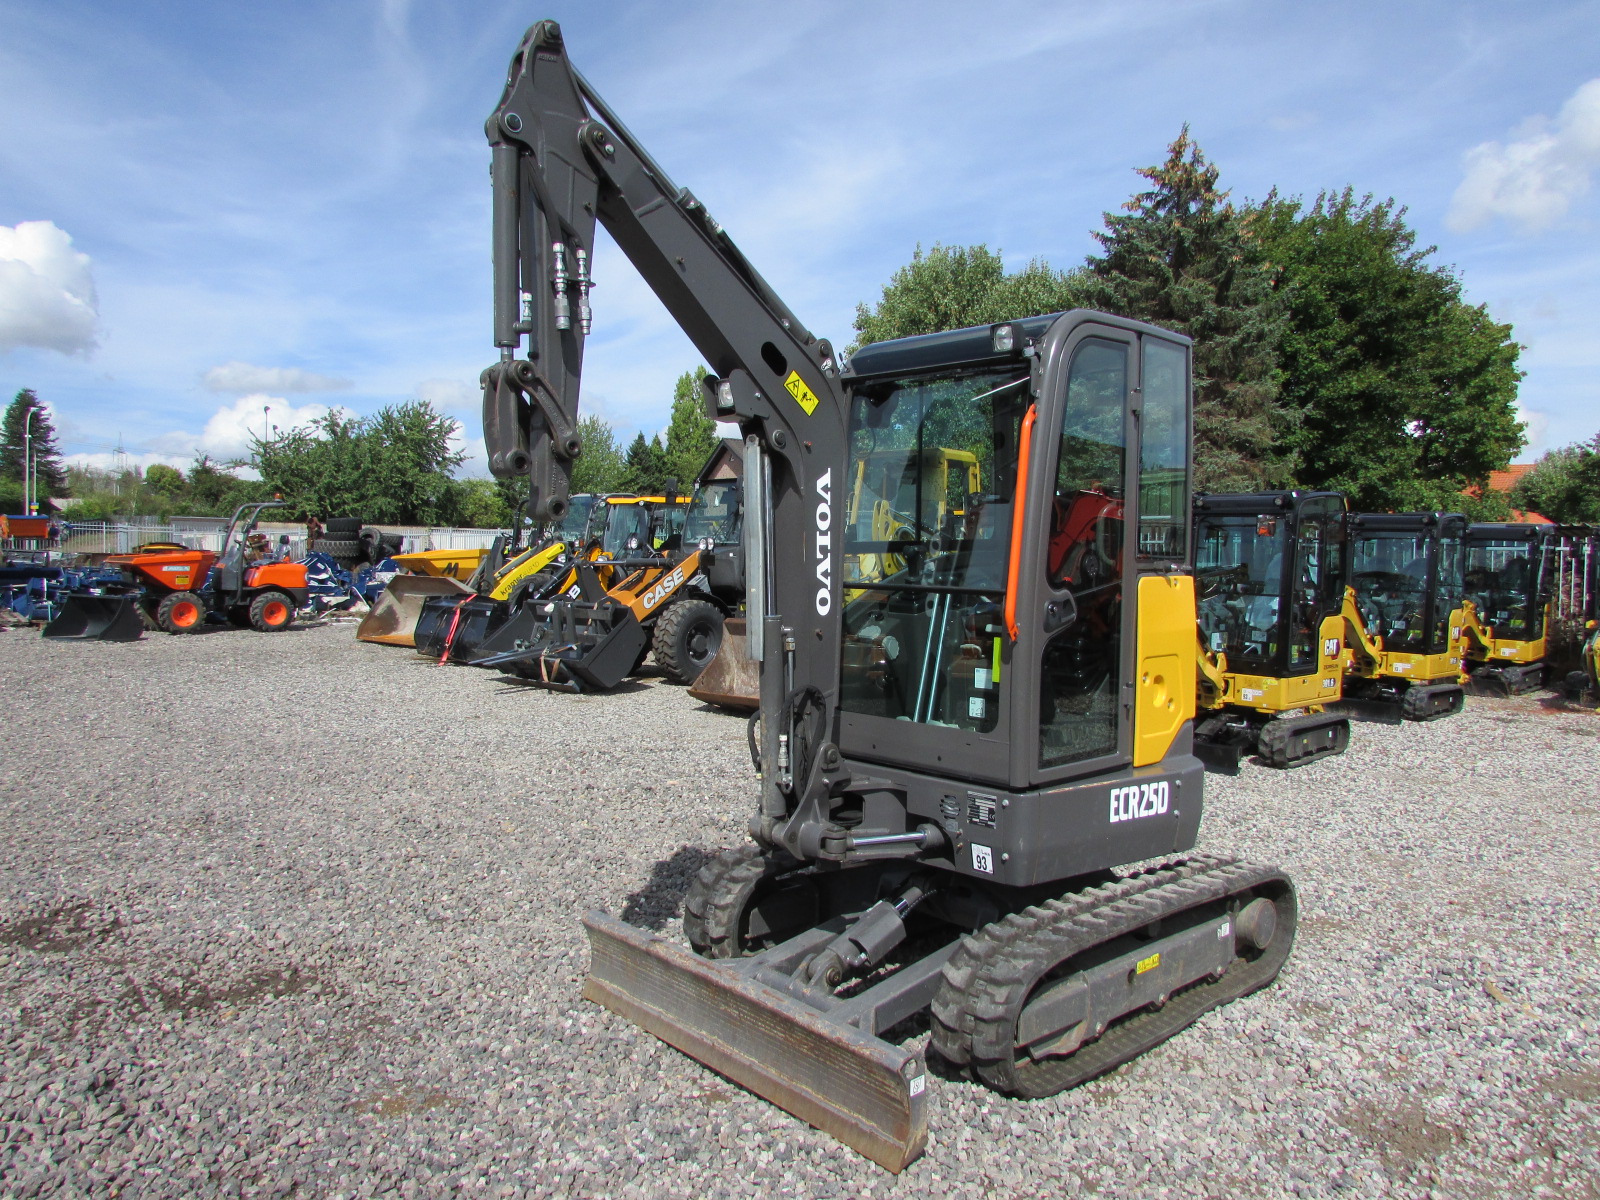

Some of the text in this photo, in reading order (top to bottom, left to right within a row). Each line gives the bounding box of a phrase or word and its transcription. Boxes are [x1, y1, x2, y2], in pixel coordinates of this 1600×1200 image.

[815, 467, 832, 616] VOLVO
[643, 566, 684, 609] CASE
[1323, 638, 1338, 656] CAT
[1109, 781, 1169, 823] ECR25D
[976, 854, 988, 871] 93
